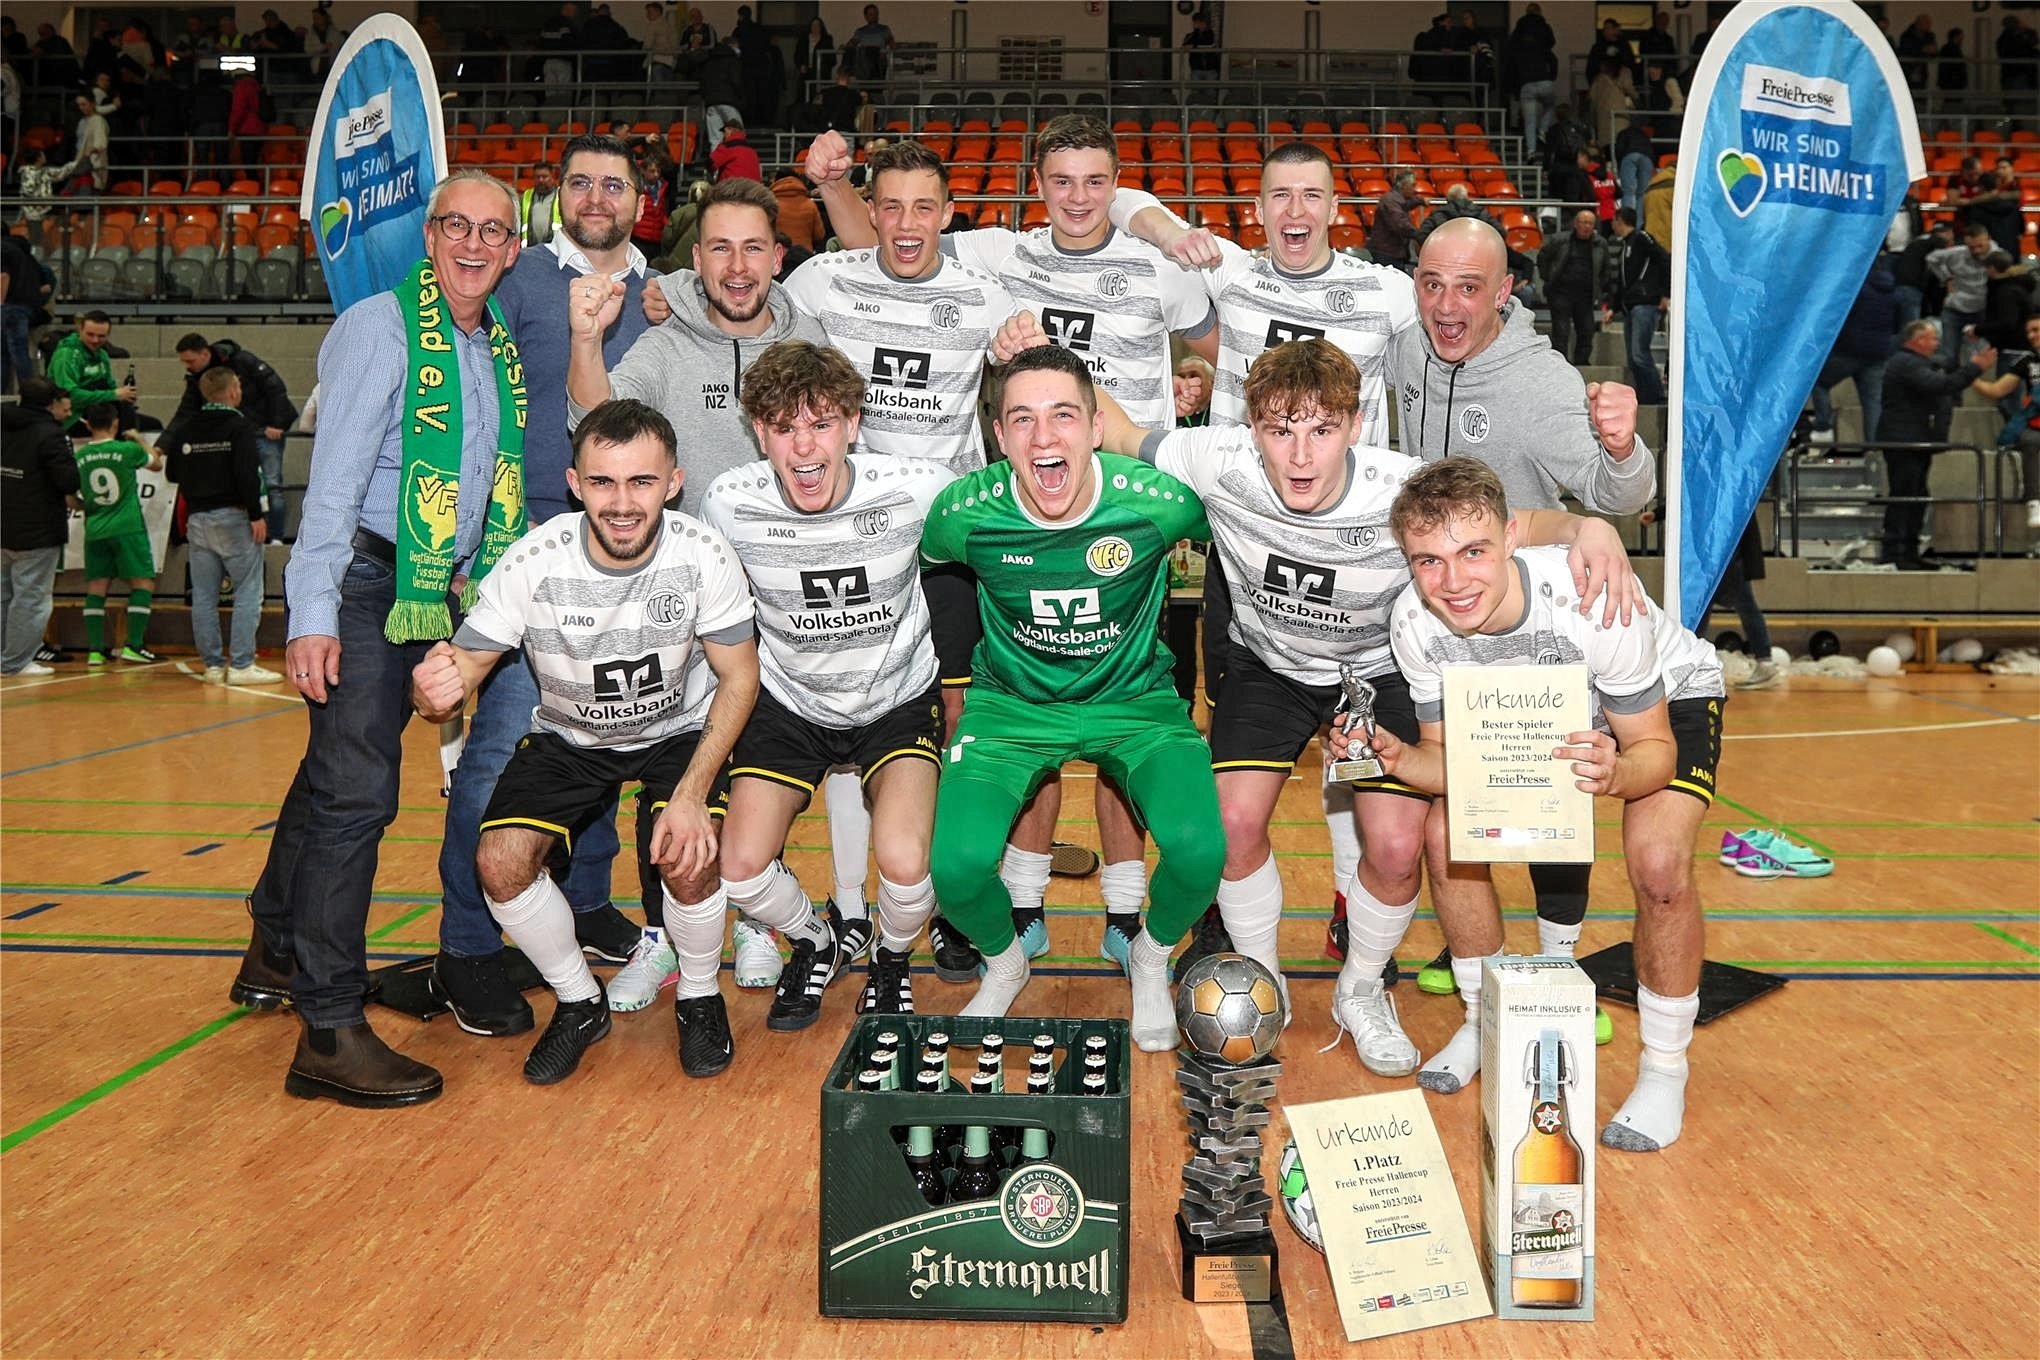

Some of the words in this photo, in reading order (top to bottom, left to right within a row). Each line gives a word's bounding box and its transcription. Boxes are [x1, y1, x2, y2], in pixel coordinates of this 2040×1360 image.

[1762, 78, 1834, 107] FreiePresse
[1752, 128, 1789, 153] WIR
[1796, 134, 1840, 158] SIND
[342, 169, 359, 190] WI
[361, 151, 390, 180] SIND
[1773, 162, 1874, 200] HEIMAT!
[1028, 270, 1051, 283] JAKO
[1099, 273, 1128, 296] VFC
[1254, 280, 1281, 294] JAKO
[853, 301, 881, 314] JAKO
[1325, 287, 1354, 313] VFC
[931, 303, 960, 328] VFC
[701, 383, 730, 394] JAKO
[864, 389, 942, 411] olksbank
[705, 395, 727, 410] NZ
[861, 406, 937, 424] land-Saale-Orla
[1464, 407, 1488, 438] VFC
[89, 467, 120, 506] 9
[767, 527, 797, 539] JAKO
[855, 508, 889, 535] VFC
[1001, 553, 1034, 566] JAKO
[1092, 542, 1128, 569] VFC
[650, 594, 686, 623] VFC
[789, 604, 894, 631] Volksbank
[562, 615, 595, 627] JAKO
[1018, 620, 1122, 645] Volksbank
[782, 623, 892, 644] Vogtland-Saale-Orla
[575, 688, 682, 720] Volksbank
[1466, 685, 1565, 711] Urkunde
[1481, 720, 1514, 729] Bester
[1517, 720, 1554, 731] Spieler
[1471, 733, 1492, 741] Freie
[1494, 733, 1521, 741] Presse
[1523, 733, 1566, 744] Hallencup
[1481, 754, 1509, 762] Saison
[1511, 754, 1553, 762] 2023/2024
[1508, 1005, 1537, 1013] HEIMAT
[1540, 1005, 1582, 1013] INKLUSIVE
[1316, 1114, 1413, 1149] Urkunde
[1353, 1154, 1402, 1172] 1.Platz
[1012, 1172, 1072, 1196] STERNQUELL
[1335, 1180, 1357, 1190] Freie
[1359, 1175, 1385, 1187] Presse
[1387, 1168, 1429, 1182] Hallencup
[1369, 1186, 1400, 1198] Herren
[1033, 1196, 1052, 1216] SBP
[1352, 1201, 1381, 1214] Saison
[1382, 1194, 1423, 1210] 2023/2024
[877, 1222, 925, 1244] SEIT
[943, 1208, 989, 1225] 1857
[1007, 1203, 1047, 1240] BRAUEREI
[1049, 1204, 1077, 1239] PLAUEN
[1512, 1228, 1582, 1252] Sternquell
[909, 1244, 1112, 1300] Sternquell
